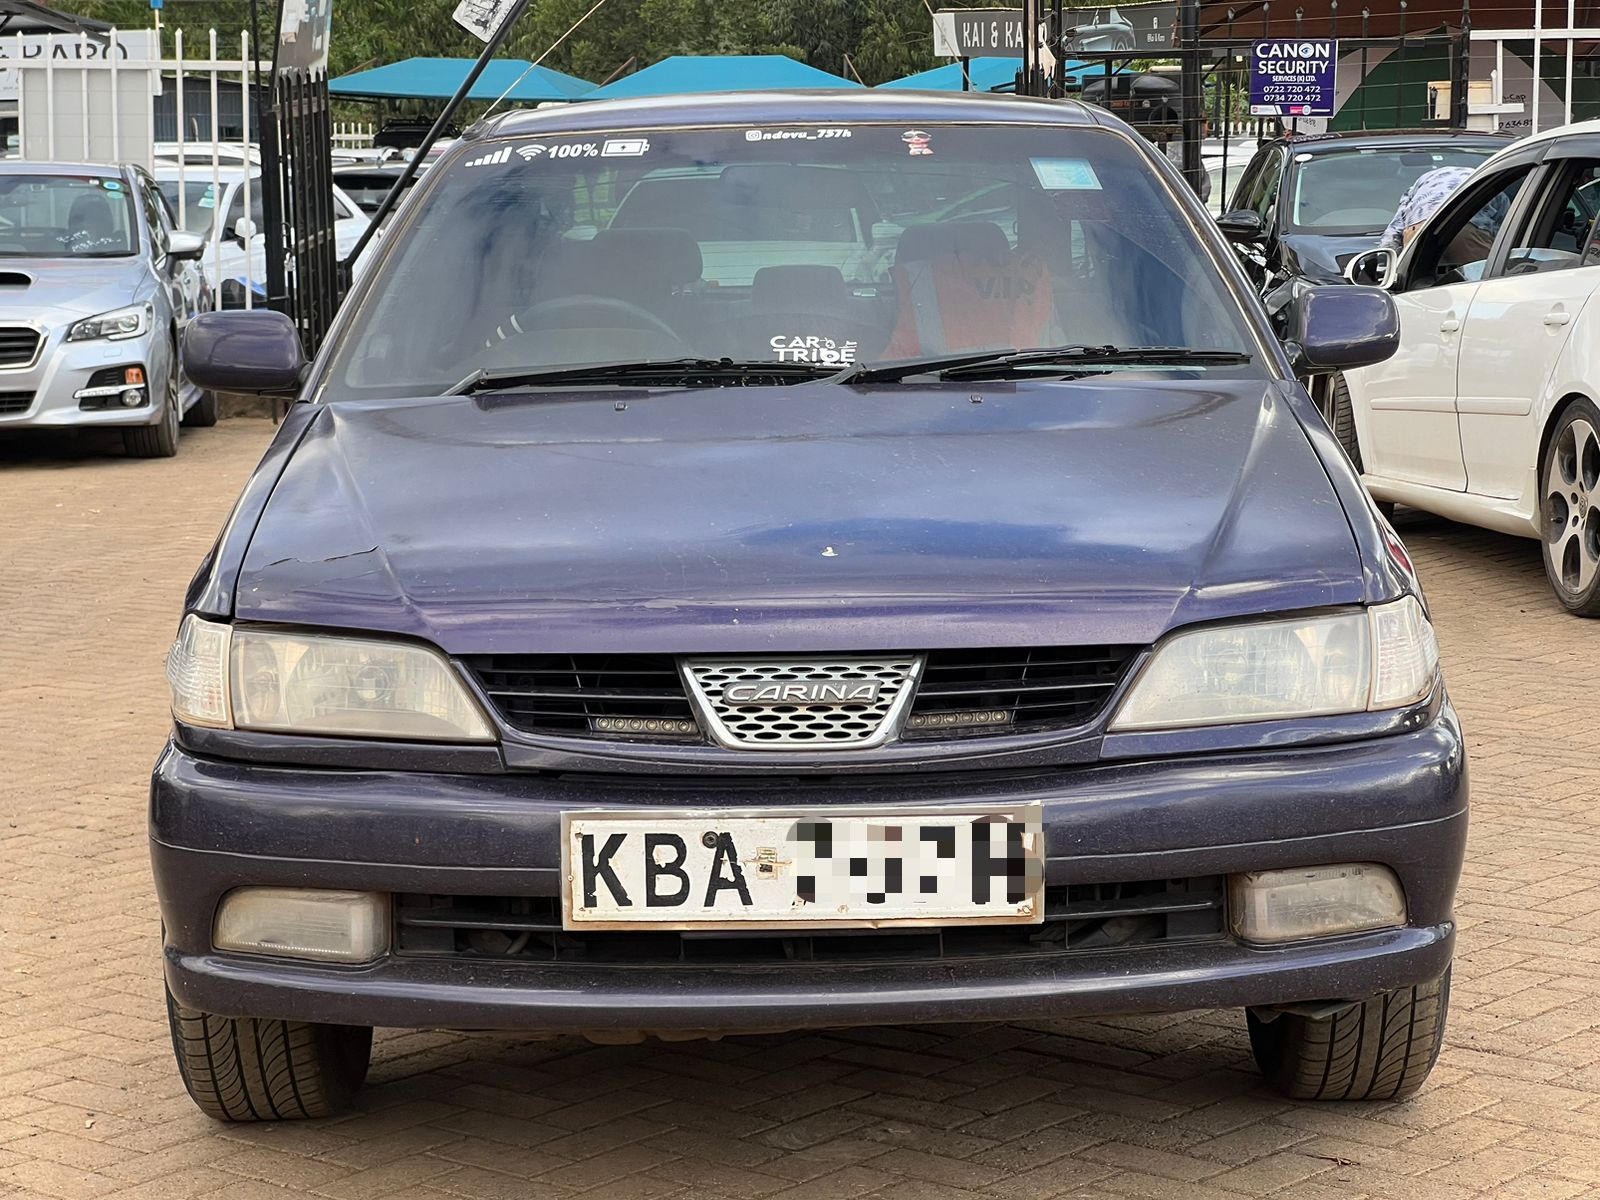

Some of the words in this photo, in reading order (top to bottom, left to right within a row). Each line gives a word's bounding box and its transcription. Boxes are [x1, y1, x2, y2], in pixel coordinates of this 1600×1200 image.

[962, 21, 985, 48] KAI
[990, 20, 999, 48] &
[1256, 43, 1330, 59] CANON
[1258, 60, 1329, 74] SECURITY
[1263, 94, 1285, 102] 0734
[1287, 94, 1304, 102] 720
[1304, 94, 1321, 102] 472
[548, 143, 599, 159] 100%
[770, 335, 821, 348] CAR
[727, 684, 876, 701] CARINA
[581, 832, 754, 908] KBA
